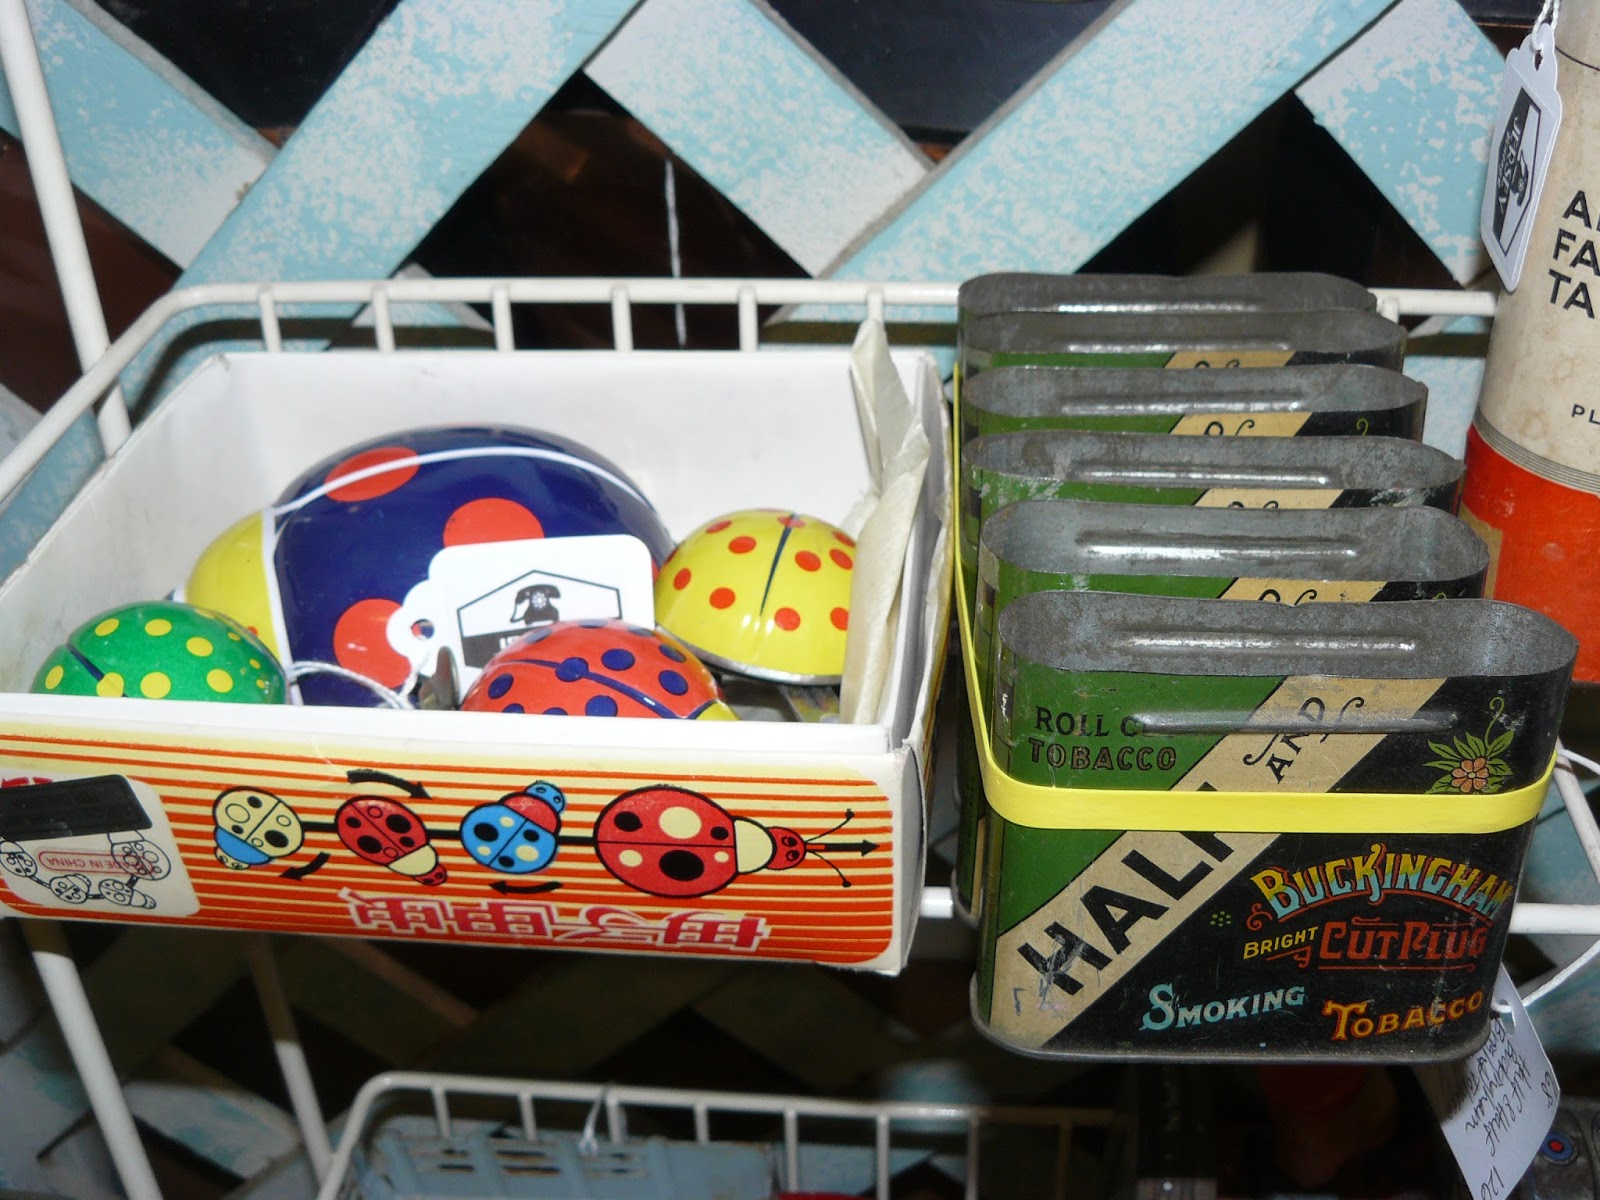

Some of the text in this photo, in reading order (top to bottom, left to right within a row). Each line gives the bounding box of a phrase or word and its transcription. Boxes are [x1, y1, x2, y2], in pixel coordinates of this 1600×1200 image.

[1562, 189, 1600, 232] A
[1035, 705, 1110, 737] ROLL
[1028, 737, 1177, 771] TOBACCO
[46, 857, 87, 868] CHINA
[90, 859, 104, 868] IN
[1250, 843, 1513, 921] BUCKINGHAM
[1243, 926, 1319, 960] BRIGHT
[1138, 982, 1306, 1031] SMOKING
[1321, 989, 1485, 1041] TOBACCO
